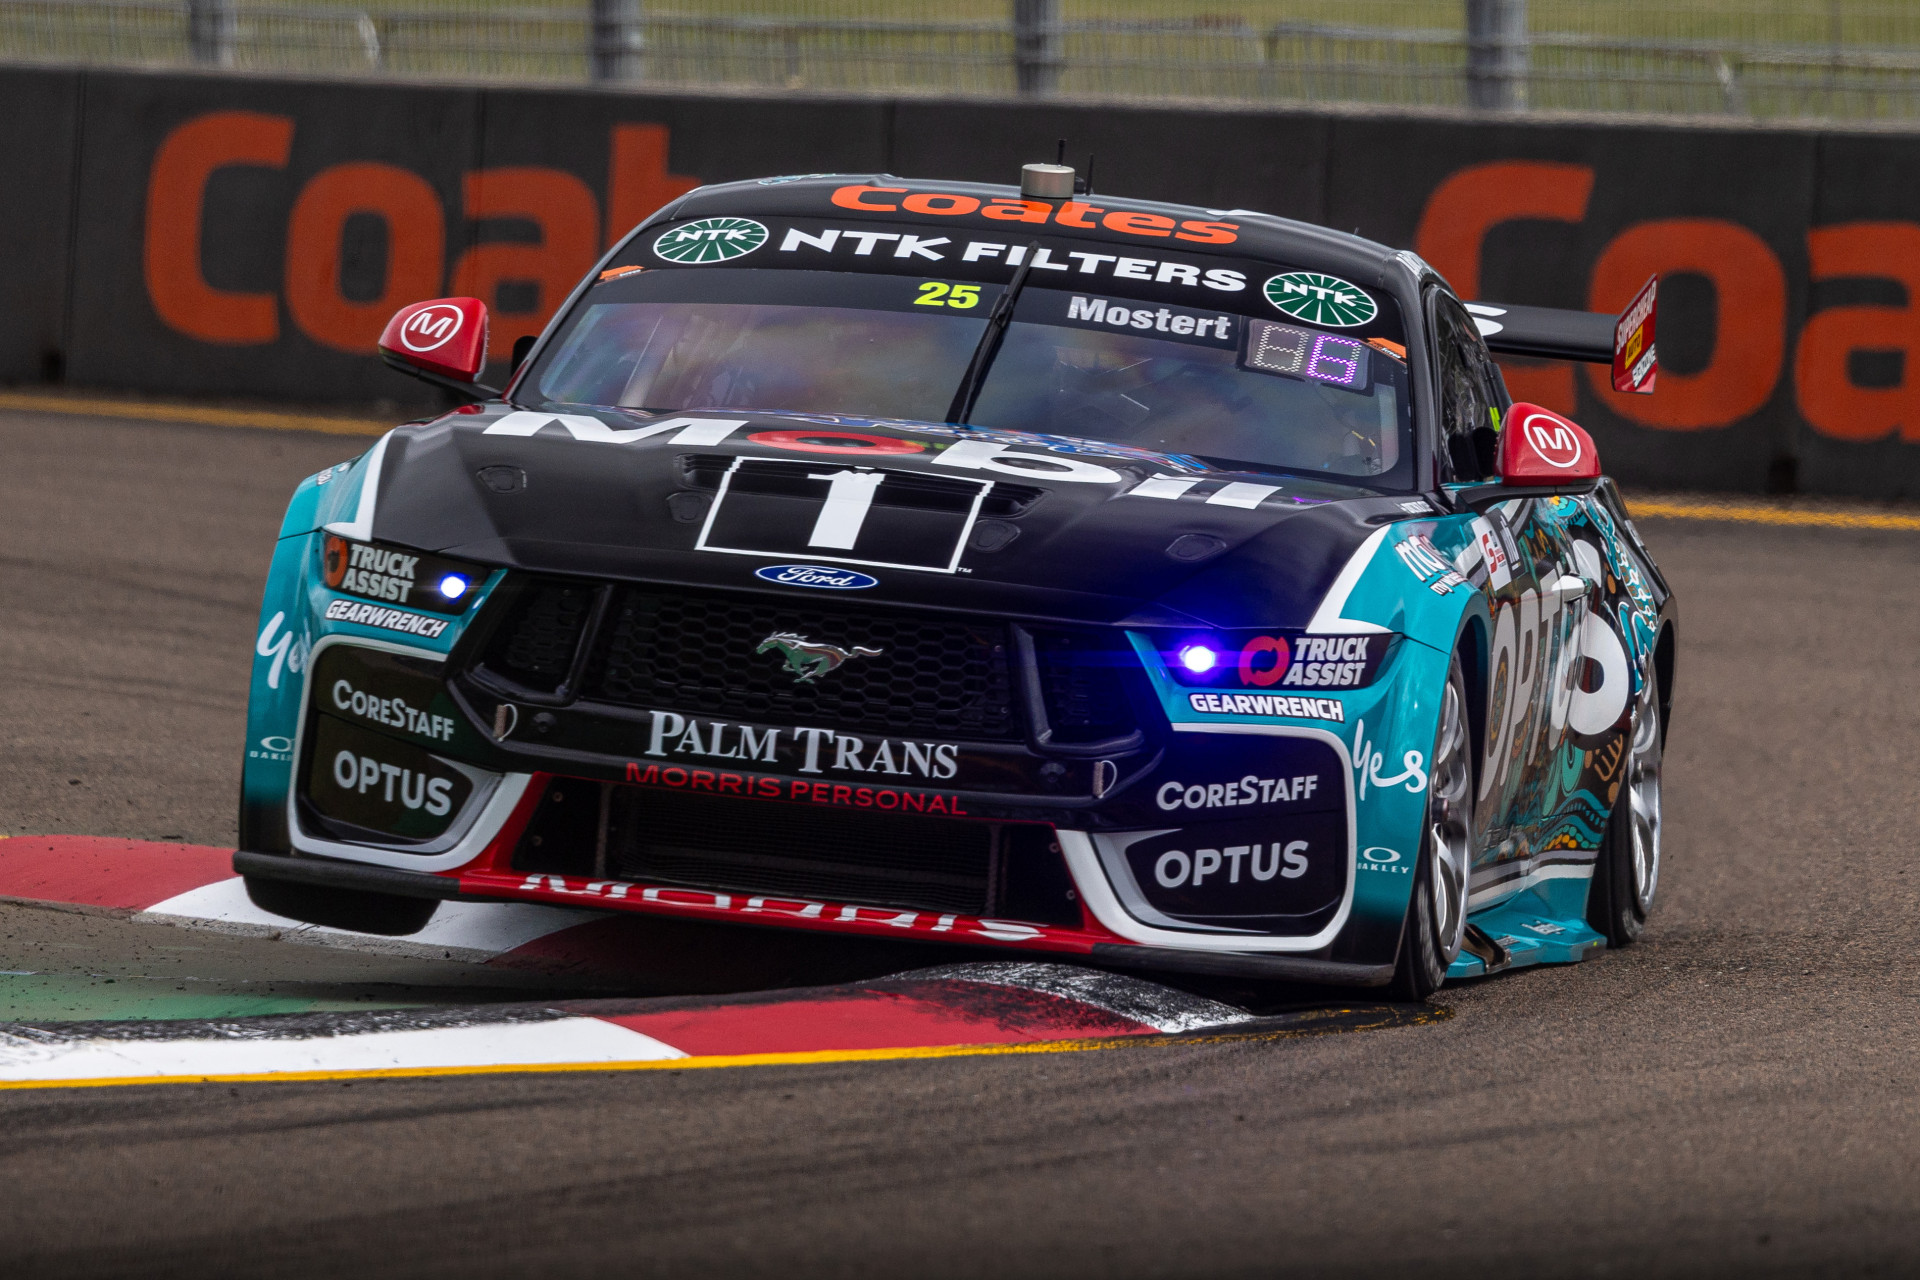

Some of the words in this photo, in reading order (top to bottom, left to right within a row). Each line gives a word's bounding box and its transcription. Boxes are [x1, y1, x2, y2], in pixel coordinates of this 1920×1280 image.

[143, 111, 702, 362] Coat
[673, 229, 752, 243] NTK
[831, 184, 1240, 246] Coates
[779, 227, 953, 263] NTK
[962, 240, 1248, 294] FILTERS
[914, 281, 981, 309] 25
[1282, 281, 1360, 309] NTK
[1414, 159, 1920, 444] Coa
[1069, 296, 1232, 342] Mostert
[483, 411, 1283, 510] Mobil
[806, 465, 885, 549] 1
[350, 544, 420, 580] TRUCK
[776, 566, 854, 587] Ford
[341, 568, 414, 603] ASSIST
[326, 600, 448, 638] GEARWRENCH
[1293, 637, 1370, 662] TRUCK
[1283, 663, 1366, 687] ASSIST
[1190, 694, 1344, 722] GEARWRENCH
[644, 710, 781, 763] PALM
[793, 727, 958, 780] TRANS
[334, 750, 454, 817] OPTUS
[626, 762, 781, 798] MORRIS
[790, 780, 968, 816] PERSONAL
[1154, 840, 1309, 889] OPTUS
